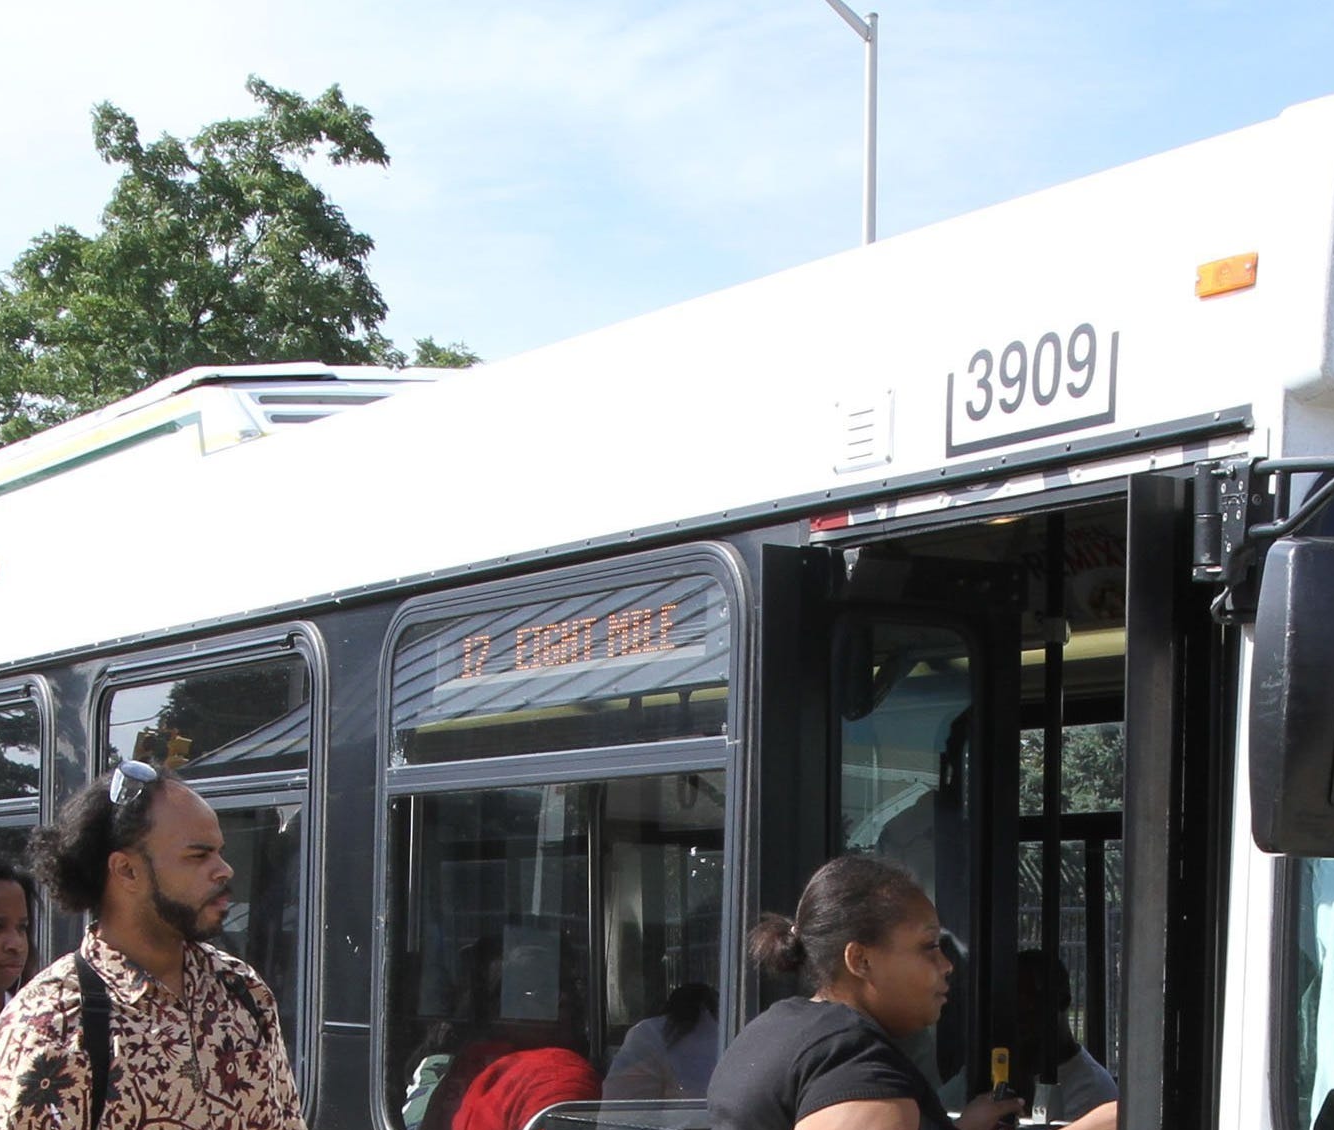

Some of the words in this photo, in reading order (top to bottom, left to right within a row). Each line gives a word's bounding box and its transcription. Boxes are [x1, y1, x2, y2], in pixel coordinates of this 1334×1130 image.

[966, 323, 1097, 421] 3909
[460, 634, 490, 679] 17
[515, 617, 598, 671] EIGHT
[606, 603, 678, 658] MILE
